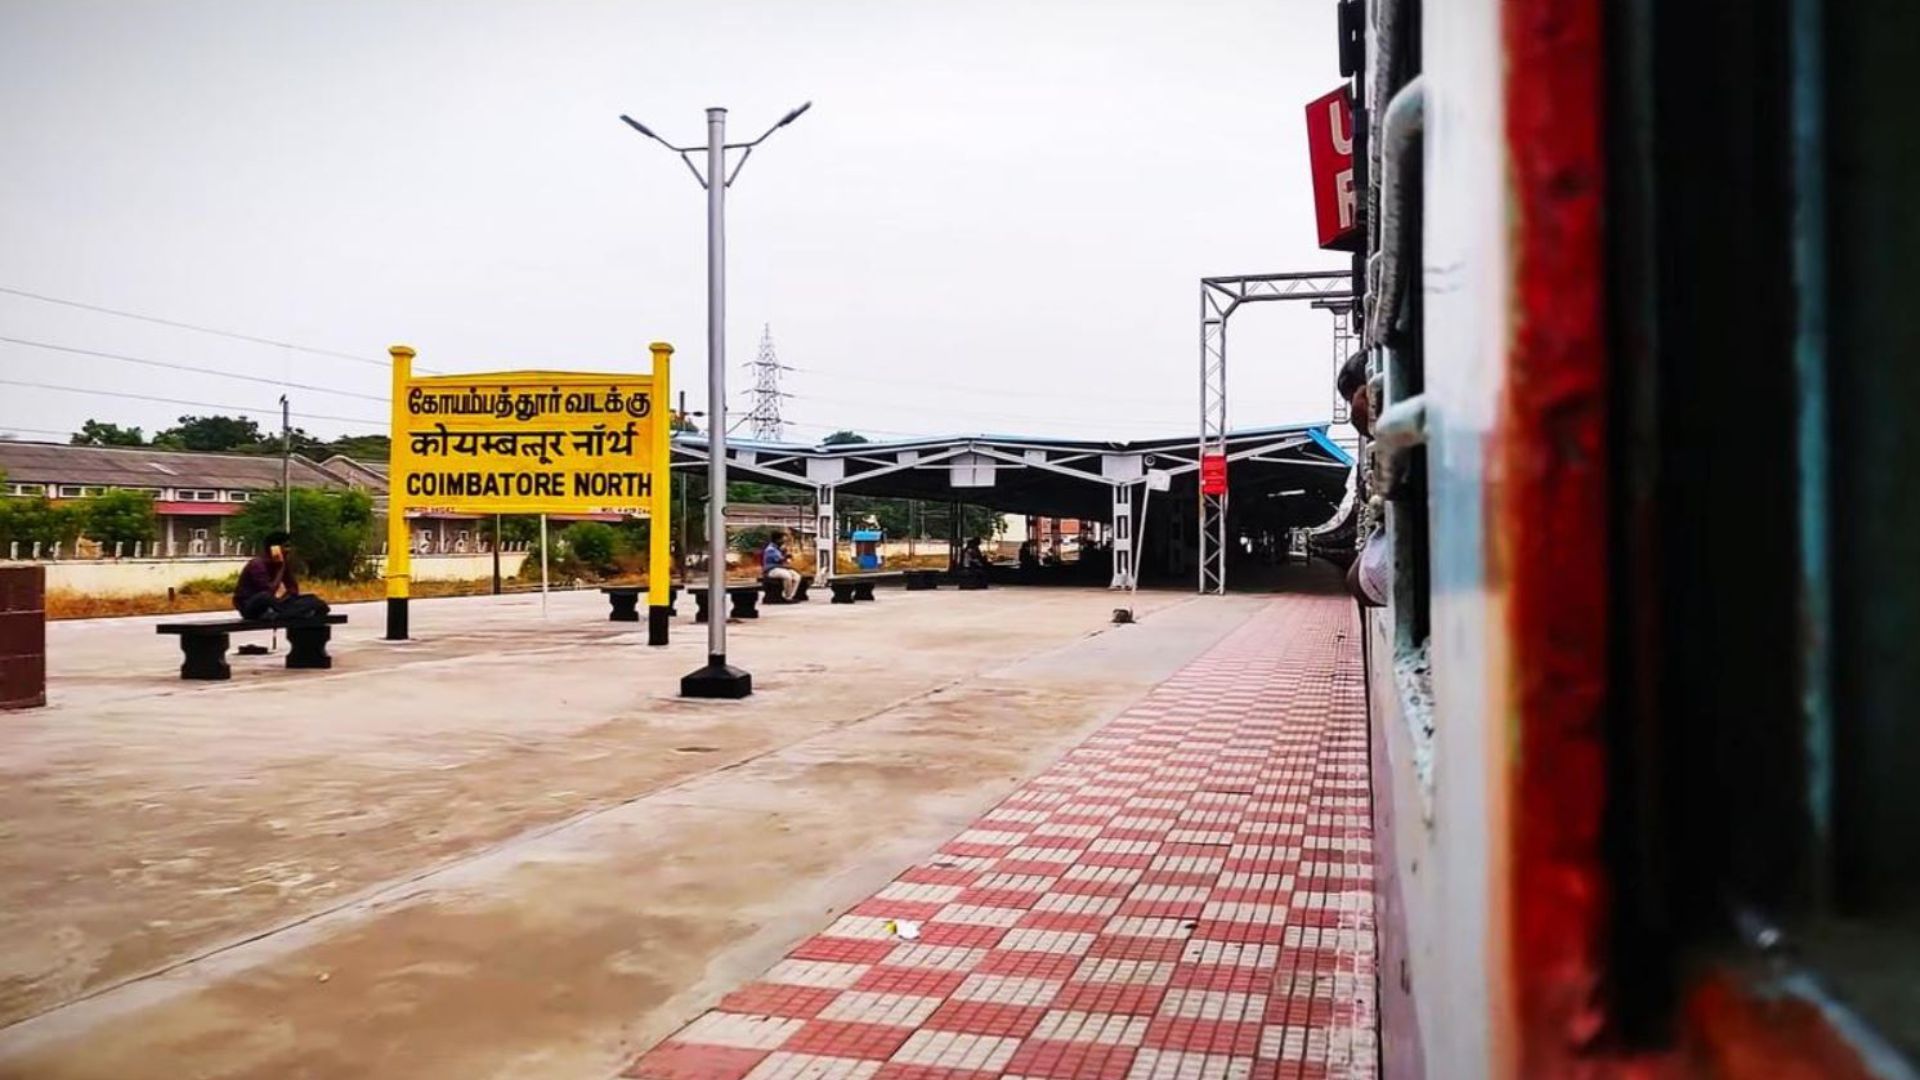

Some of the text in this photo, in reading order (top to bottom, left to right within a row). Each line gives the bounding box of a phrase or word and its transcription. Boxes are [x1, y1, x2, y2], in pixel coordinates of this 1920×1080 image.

[565, 385, 650, 417] வடக்கு
[571, 423, 639, 456] नॉर्थ
[406, 472, 652, 497] COIMBATORE NORTH
